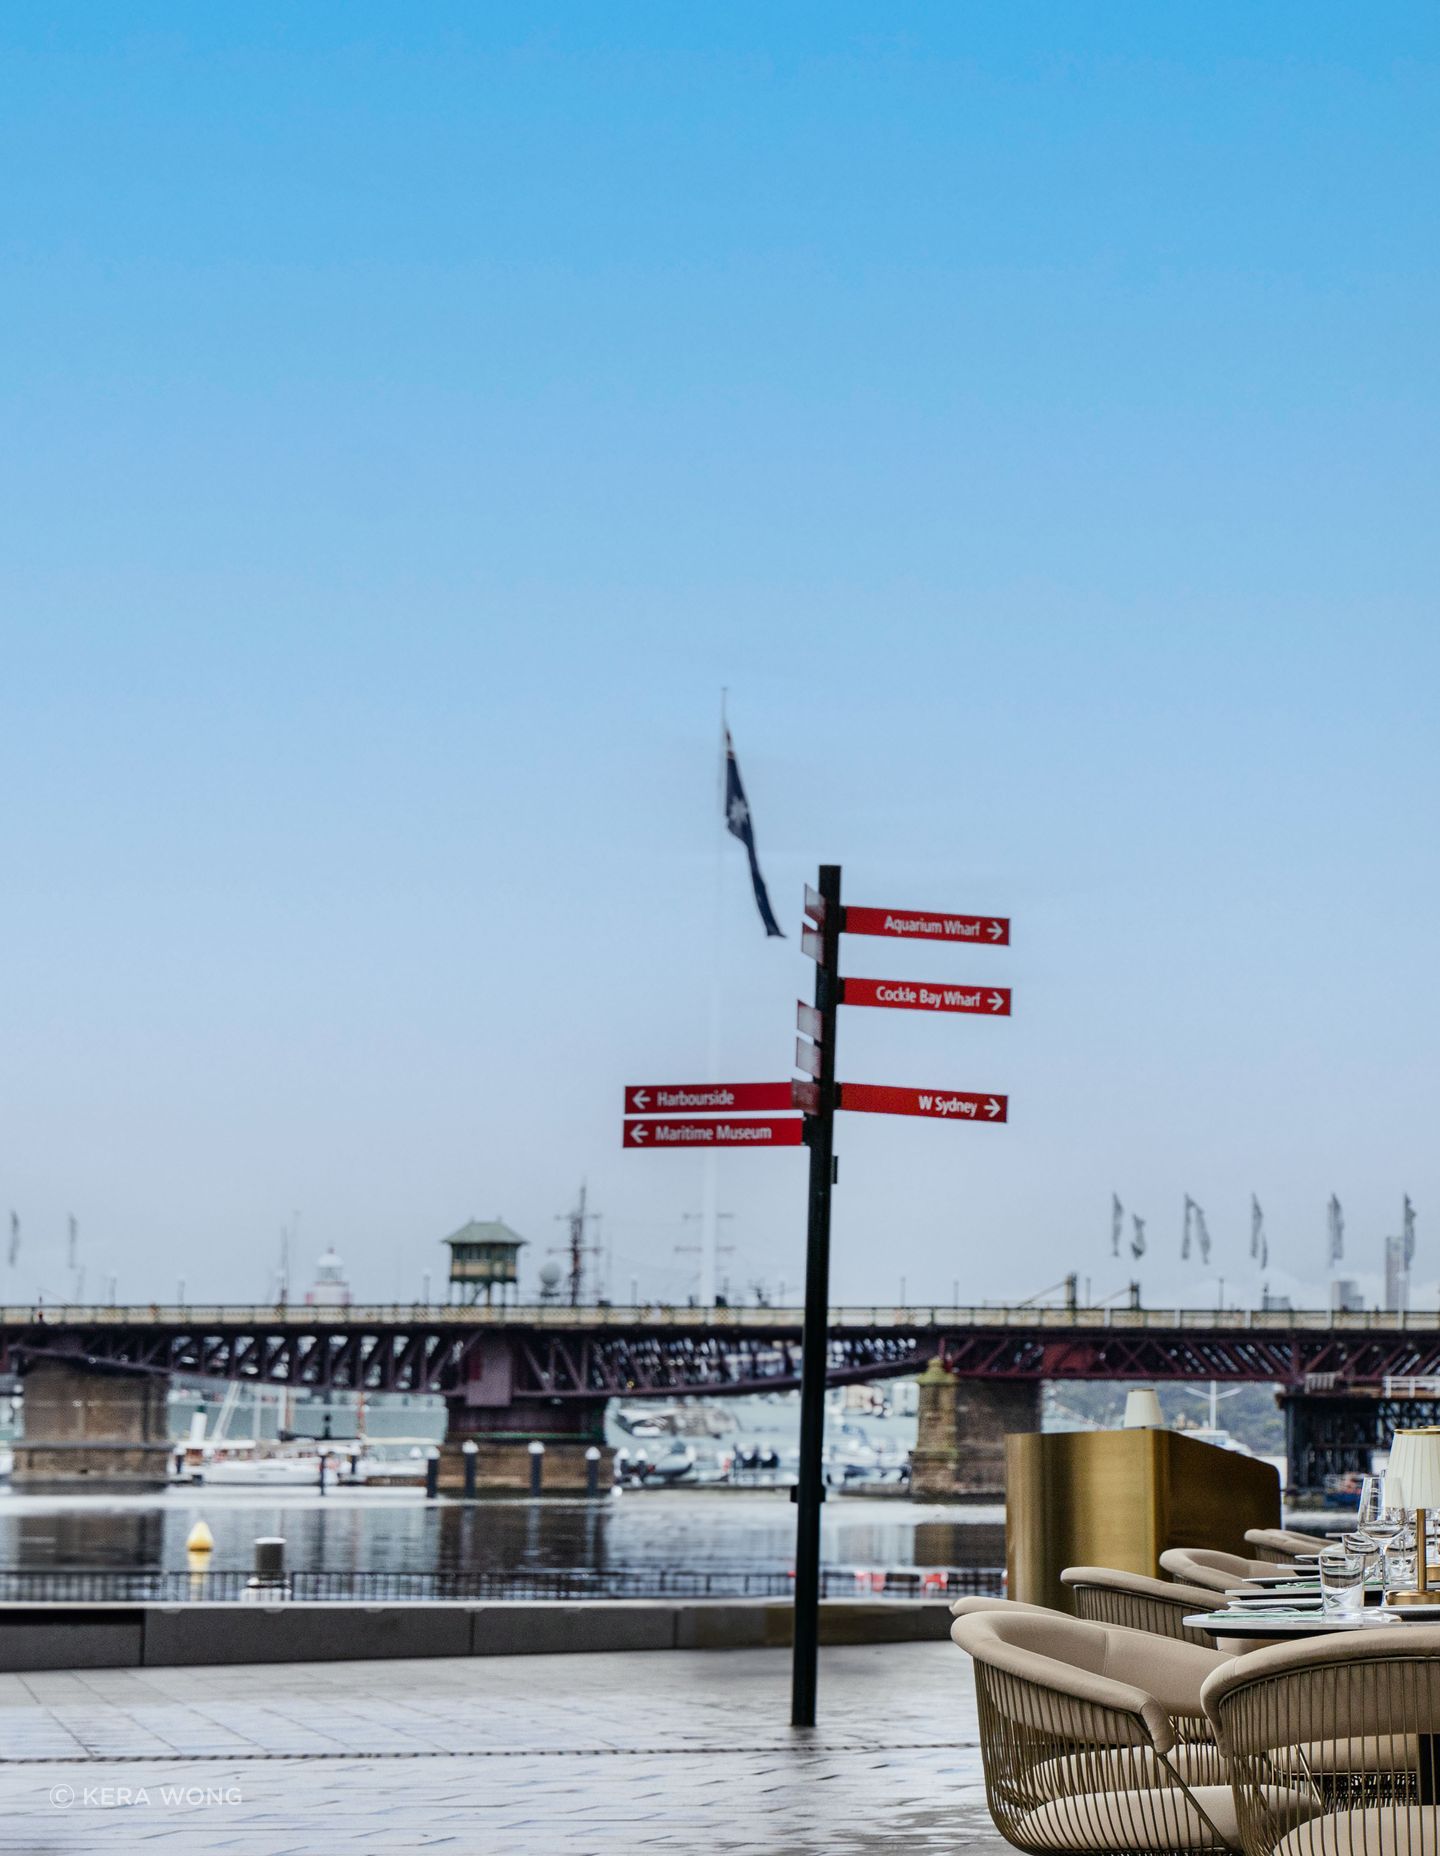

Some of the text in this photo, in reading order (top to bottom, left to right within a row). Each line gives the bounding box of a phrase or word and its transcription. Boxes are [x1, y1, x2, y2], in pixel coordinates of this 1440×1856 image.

[884, 915, 981, 936] Aquarium Wharf
[876, 985, 981, 1008] Cockle Bay Wharf
[657, 1088, 735, 1107] Harbourside
[918, 1095, 978, 1117] W Sydney
[655, 1124, 772, 1141] Maritime Museum
